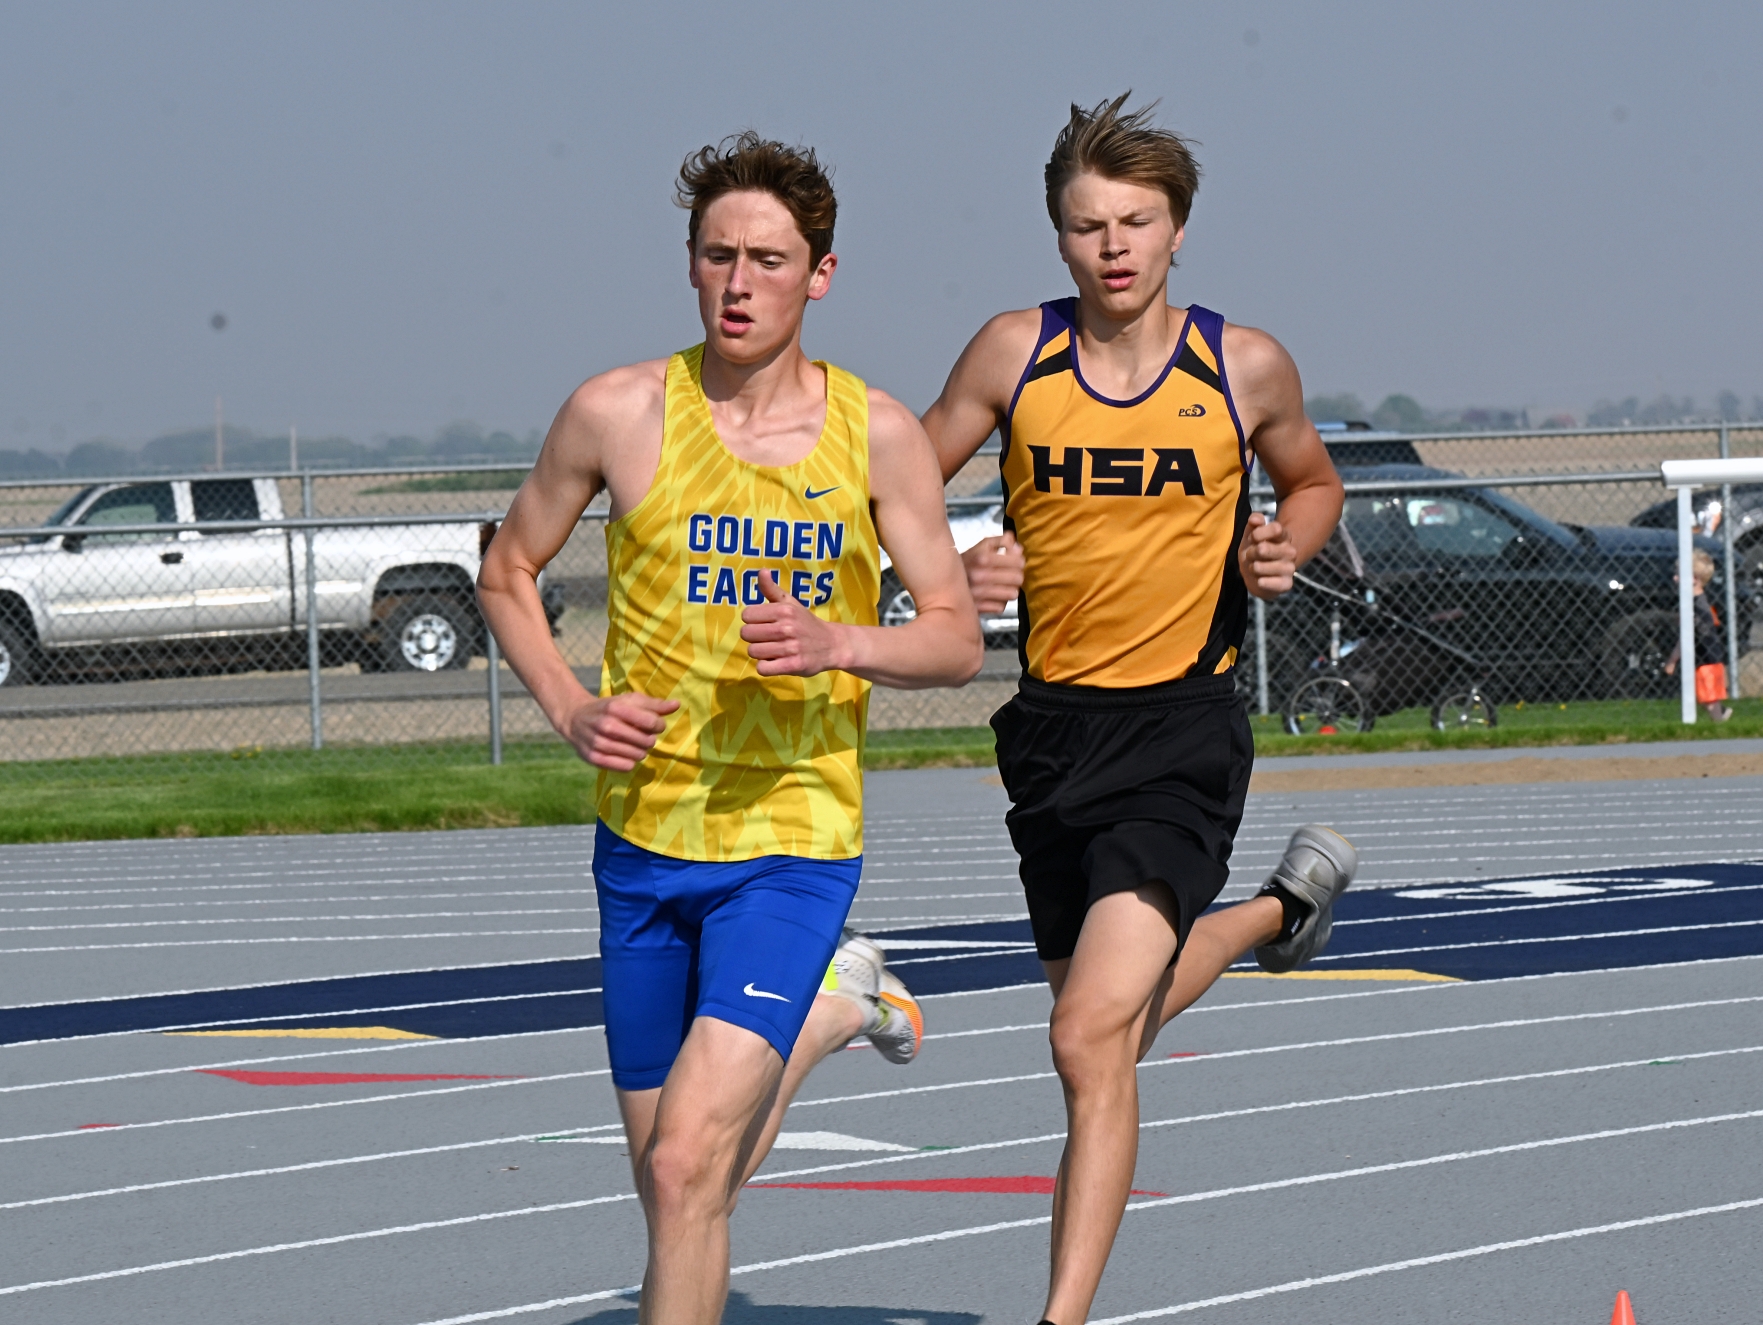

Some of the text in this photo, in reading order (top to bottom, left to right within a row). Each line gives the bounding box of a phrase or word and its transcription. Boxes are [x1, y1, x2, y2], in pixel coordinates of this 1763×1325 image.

[1178, 407, 1200, 417] PCS
[1027, 444, 1205, 497] HSA
[688, 513, 844, 560] GOLDEN
